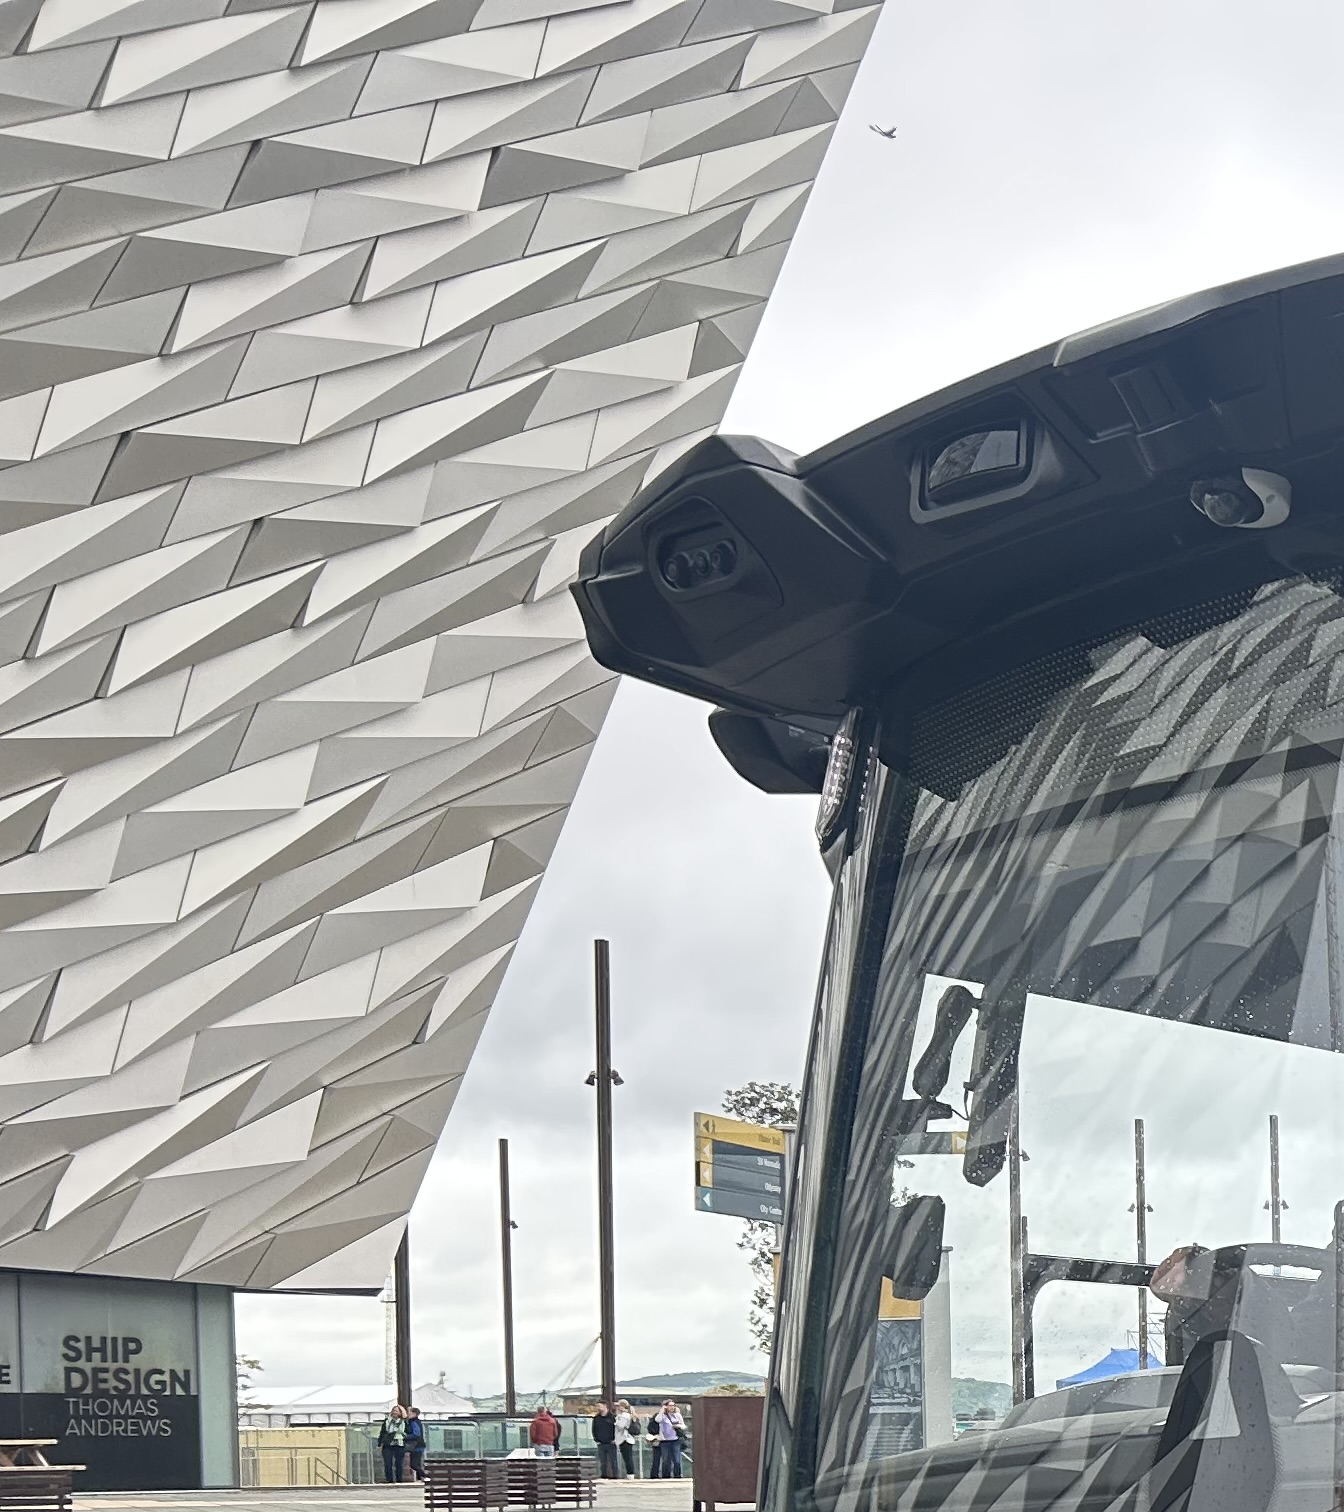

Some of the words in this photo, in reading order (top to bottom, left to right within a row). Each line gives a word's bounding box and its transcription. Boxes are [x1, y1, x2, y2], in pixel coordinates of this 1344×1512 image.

[61, 1334, 143, 1364] SHIP
[63, 1366, 191, 1396] DESIGN
[64, 1398, 159, 1417] THOMAS
[65, 1419, 172, 1437] ANDREWS
